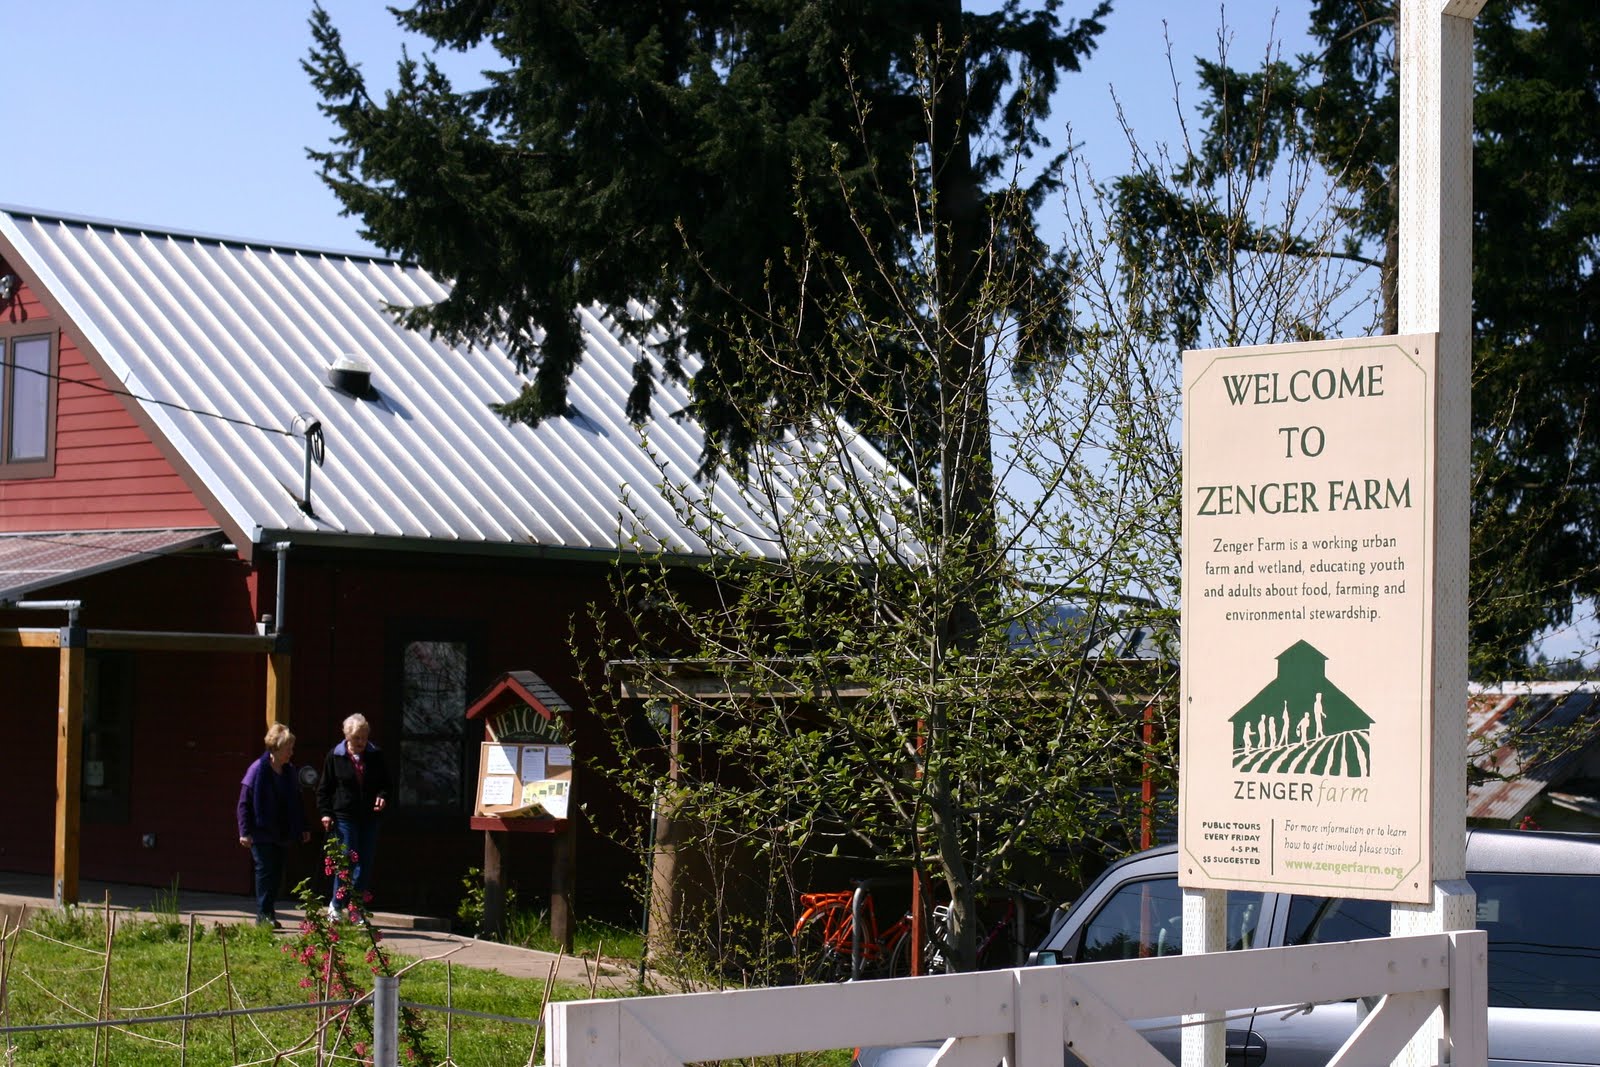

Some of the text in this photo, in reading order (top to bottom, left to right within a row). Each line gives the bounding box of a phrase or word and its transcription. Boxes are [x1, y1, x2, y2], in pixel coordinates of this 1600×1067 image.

[1223, 365, 1384, 406] WELCOME
[1279, 426, 1325, 458] TO
[1197, 477, 1412, 516] ZENGER FARM
[1213, 535, 1396, 555] Zenger Farm is a working urban
[1205, 557, 1405, 575] farm and wetland, educating youth
[1204, 580, 1406, 597] and adults about food, farming and
[1225, 605, 1381, 622] environmental stewardship.
[1234, 779, 1369, 807] ZENGER farm
[1202, 821, 1231, 829] PUBLIC
[1285, 820, 1298, 831] For
[1300, 824, 1318, 833] more
[1320, 821, 1364, 836] information
[1377, 826, 1385, 836] to
[1387, 825, 1407, 836] learn
[1284, 837, 1403, 856] how to get involved please visit:
[1213, 856, 1261, 865] SUGGESTED
[1285, 860, 1404, 879] www.zengerfarm.org
